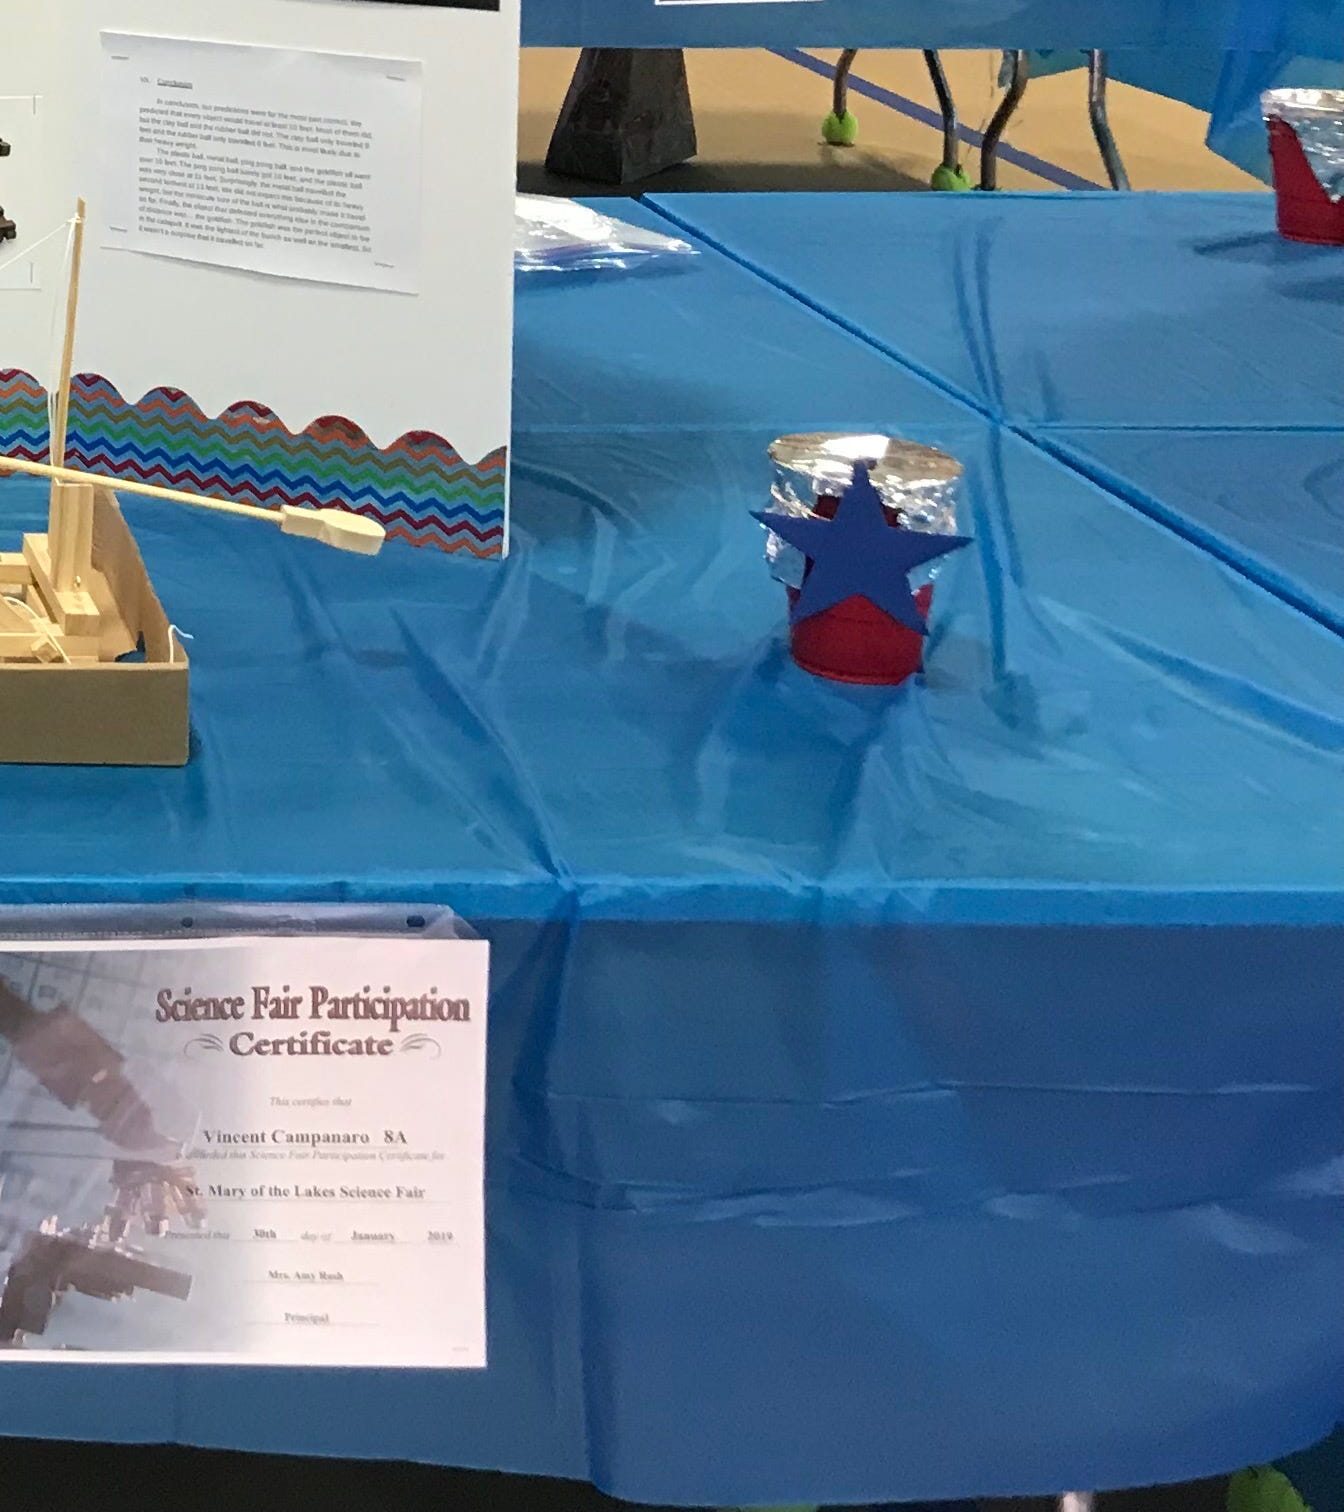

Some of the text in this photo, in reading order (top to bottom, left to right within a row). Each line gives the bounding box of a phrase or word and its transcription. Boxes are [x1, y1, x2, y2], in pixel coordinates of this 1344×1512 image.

[156, 985, 470, 1032] Science Fair Participation
[229, 1030, 394, 1056] Certificate
[270, 1096, 290, 1107] This
[332, 1096, 352, 1107] that
[203, 1129, 408, 1147] Vincent Campanaro 8A
[185, 1185, 426, 1201] St. Mary of the Lakes Science Fair
[253, 1229, 453, 1242] 30th January 2019
[294, 1270, 315, 1282] Amy
[319, 1270, 344, 1281] Rush
[284, 1312, 330, 1324] Principal
